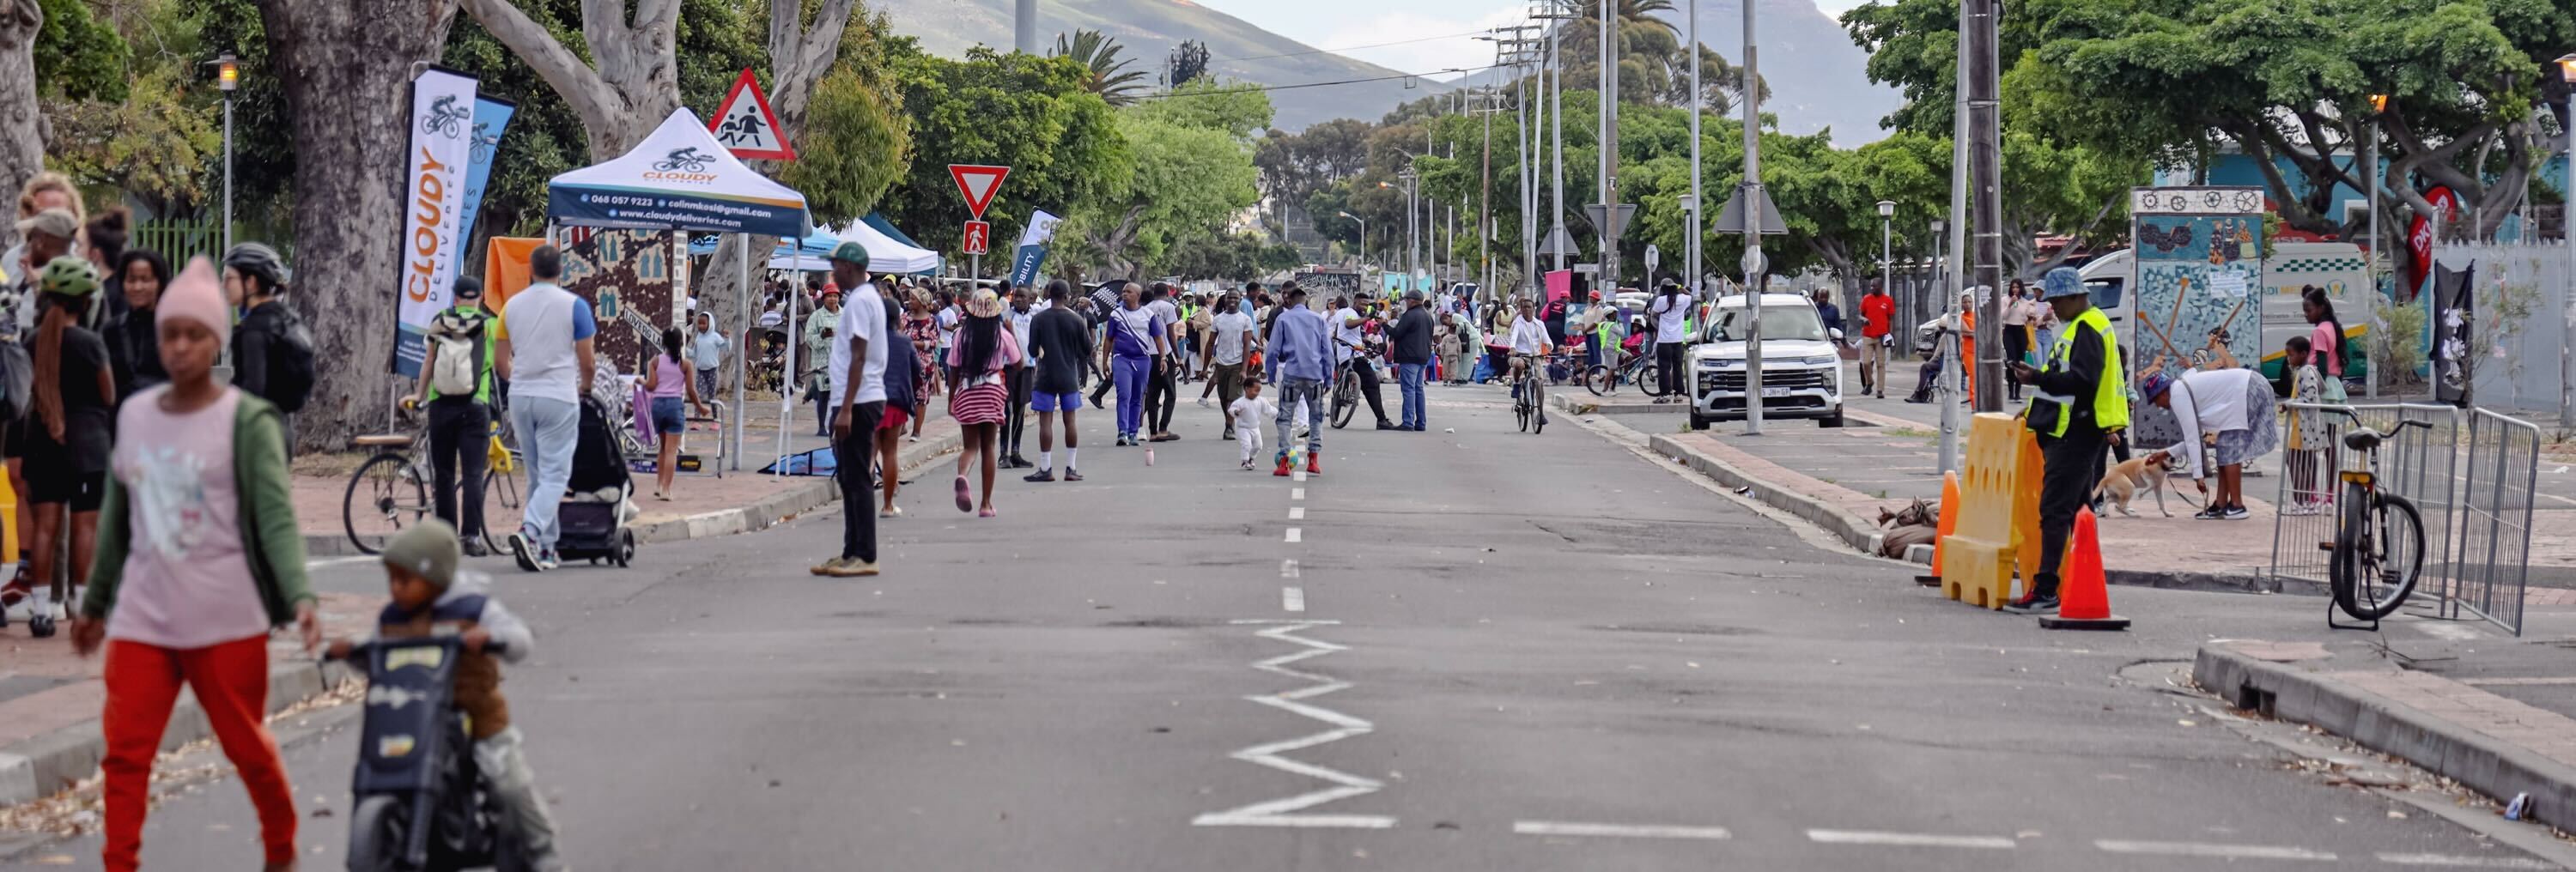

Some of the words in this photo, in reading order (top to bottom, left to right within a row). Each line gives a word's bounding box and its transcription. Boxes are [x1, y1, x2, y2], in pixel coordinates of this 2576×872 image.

[642, 172, 718, 181] CLOUDY
[591, 195, 610, 203] 068
[611, 196, 629, 204] 057
[630, 197, 653, 207] 9223
[408, 146, 446, 303] CLOUDY
[619, 210, 742, 227] www.cloudydeliveries.com
[1016, 251, 1035, 286] OBILITY
[2262, 287, 2278, 295] ADI
[625, 311, 653, 338] LOVERS
